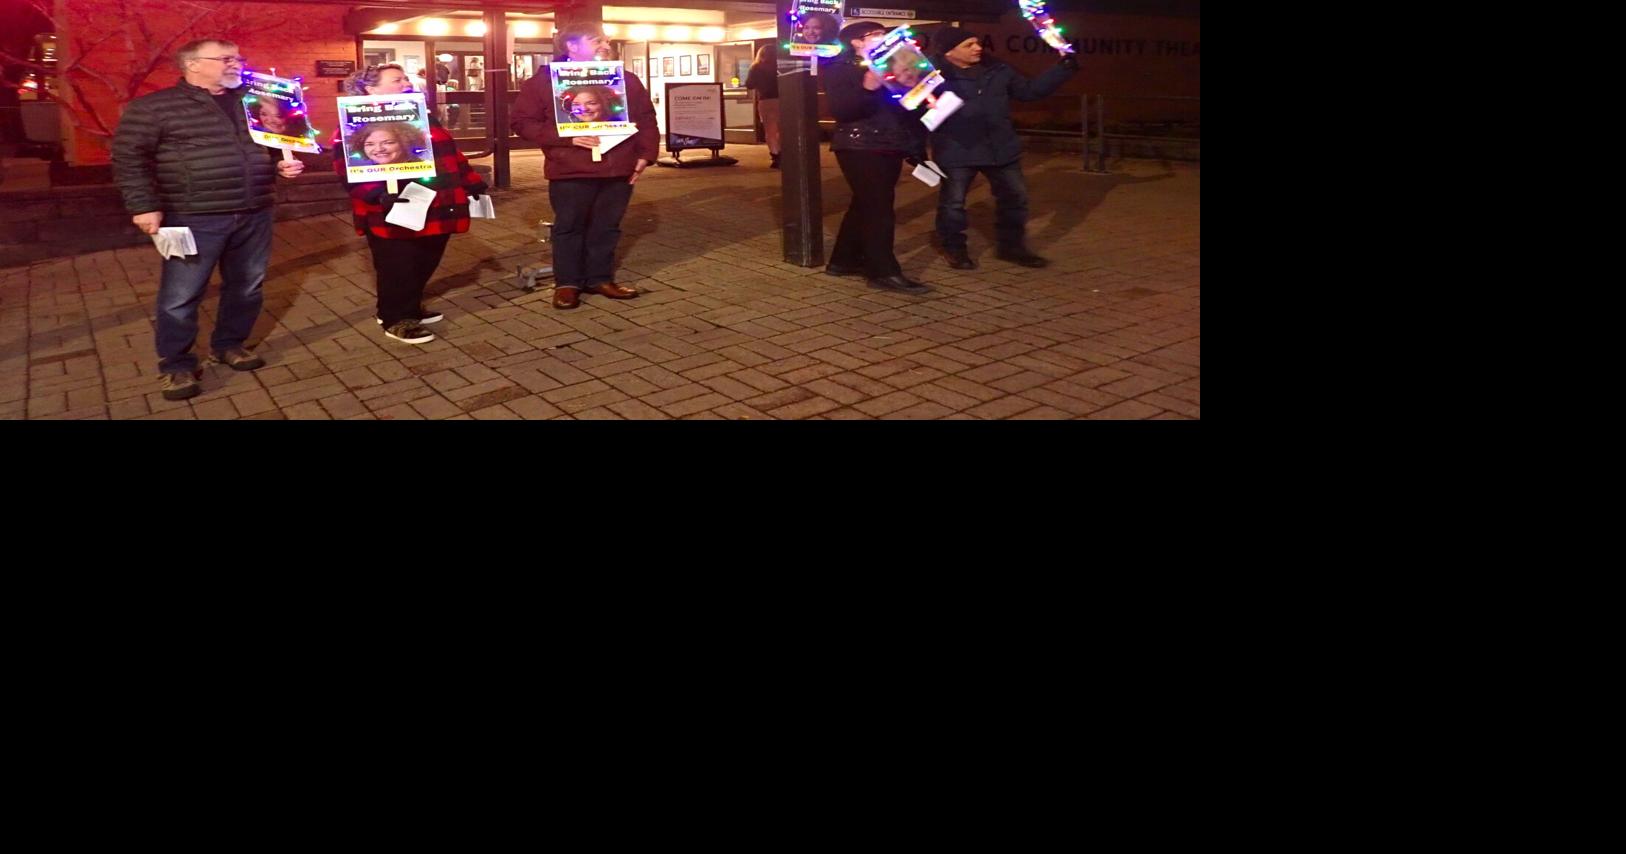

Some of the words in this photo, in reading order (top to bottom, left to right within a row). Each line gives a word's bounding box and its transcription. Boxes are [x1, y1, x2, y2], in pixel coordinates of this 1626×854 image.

[799, 5, 836, 14] Rosemary
[1007, 35, 1146, 55] COUNITY
[558, 68, 588, 77] Brin
[352, 113, 416, 123] Rosemary
[388, 164, 433, 172] Orchestra
